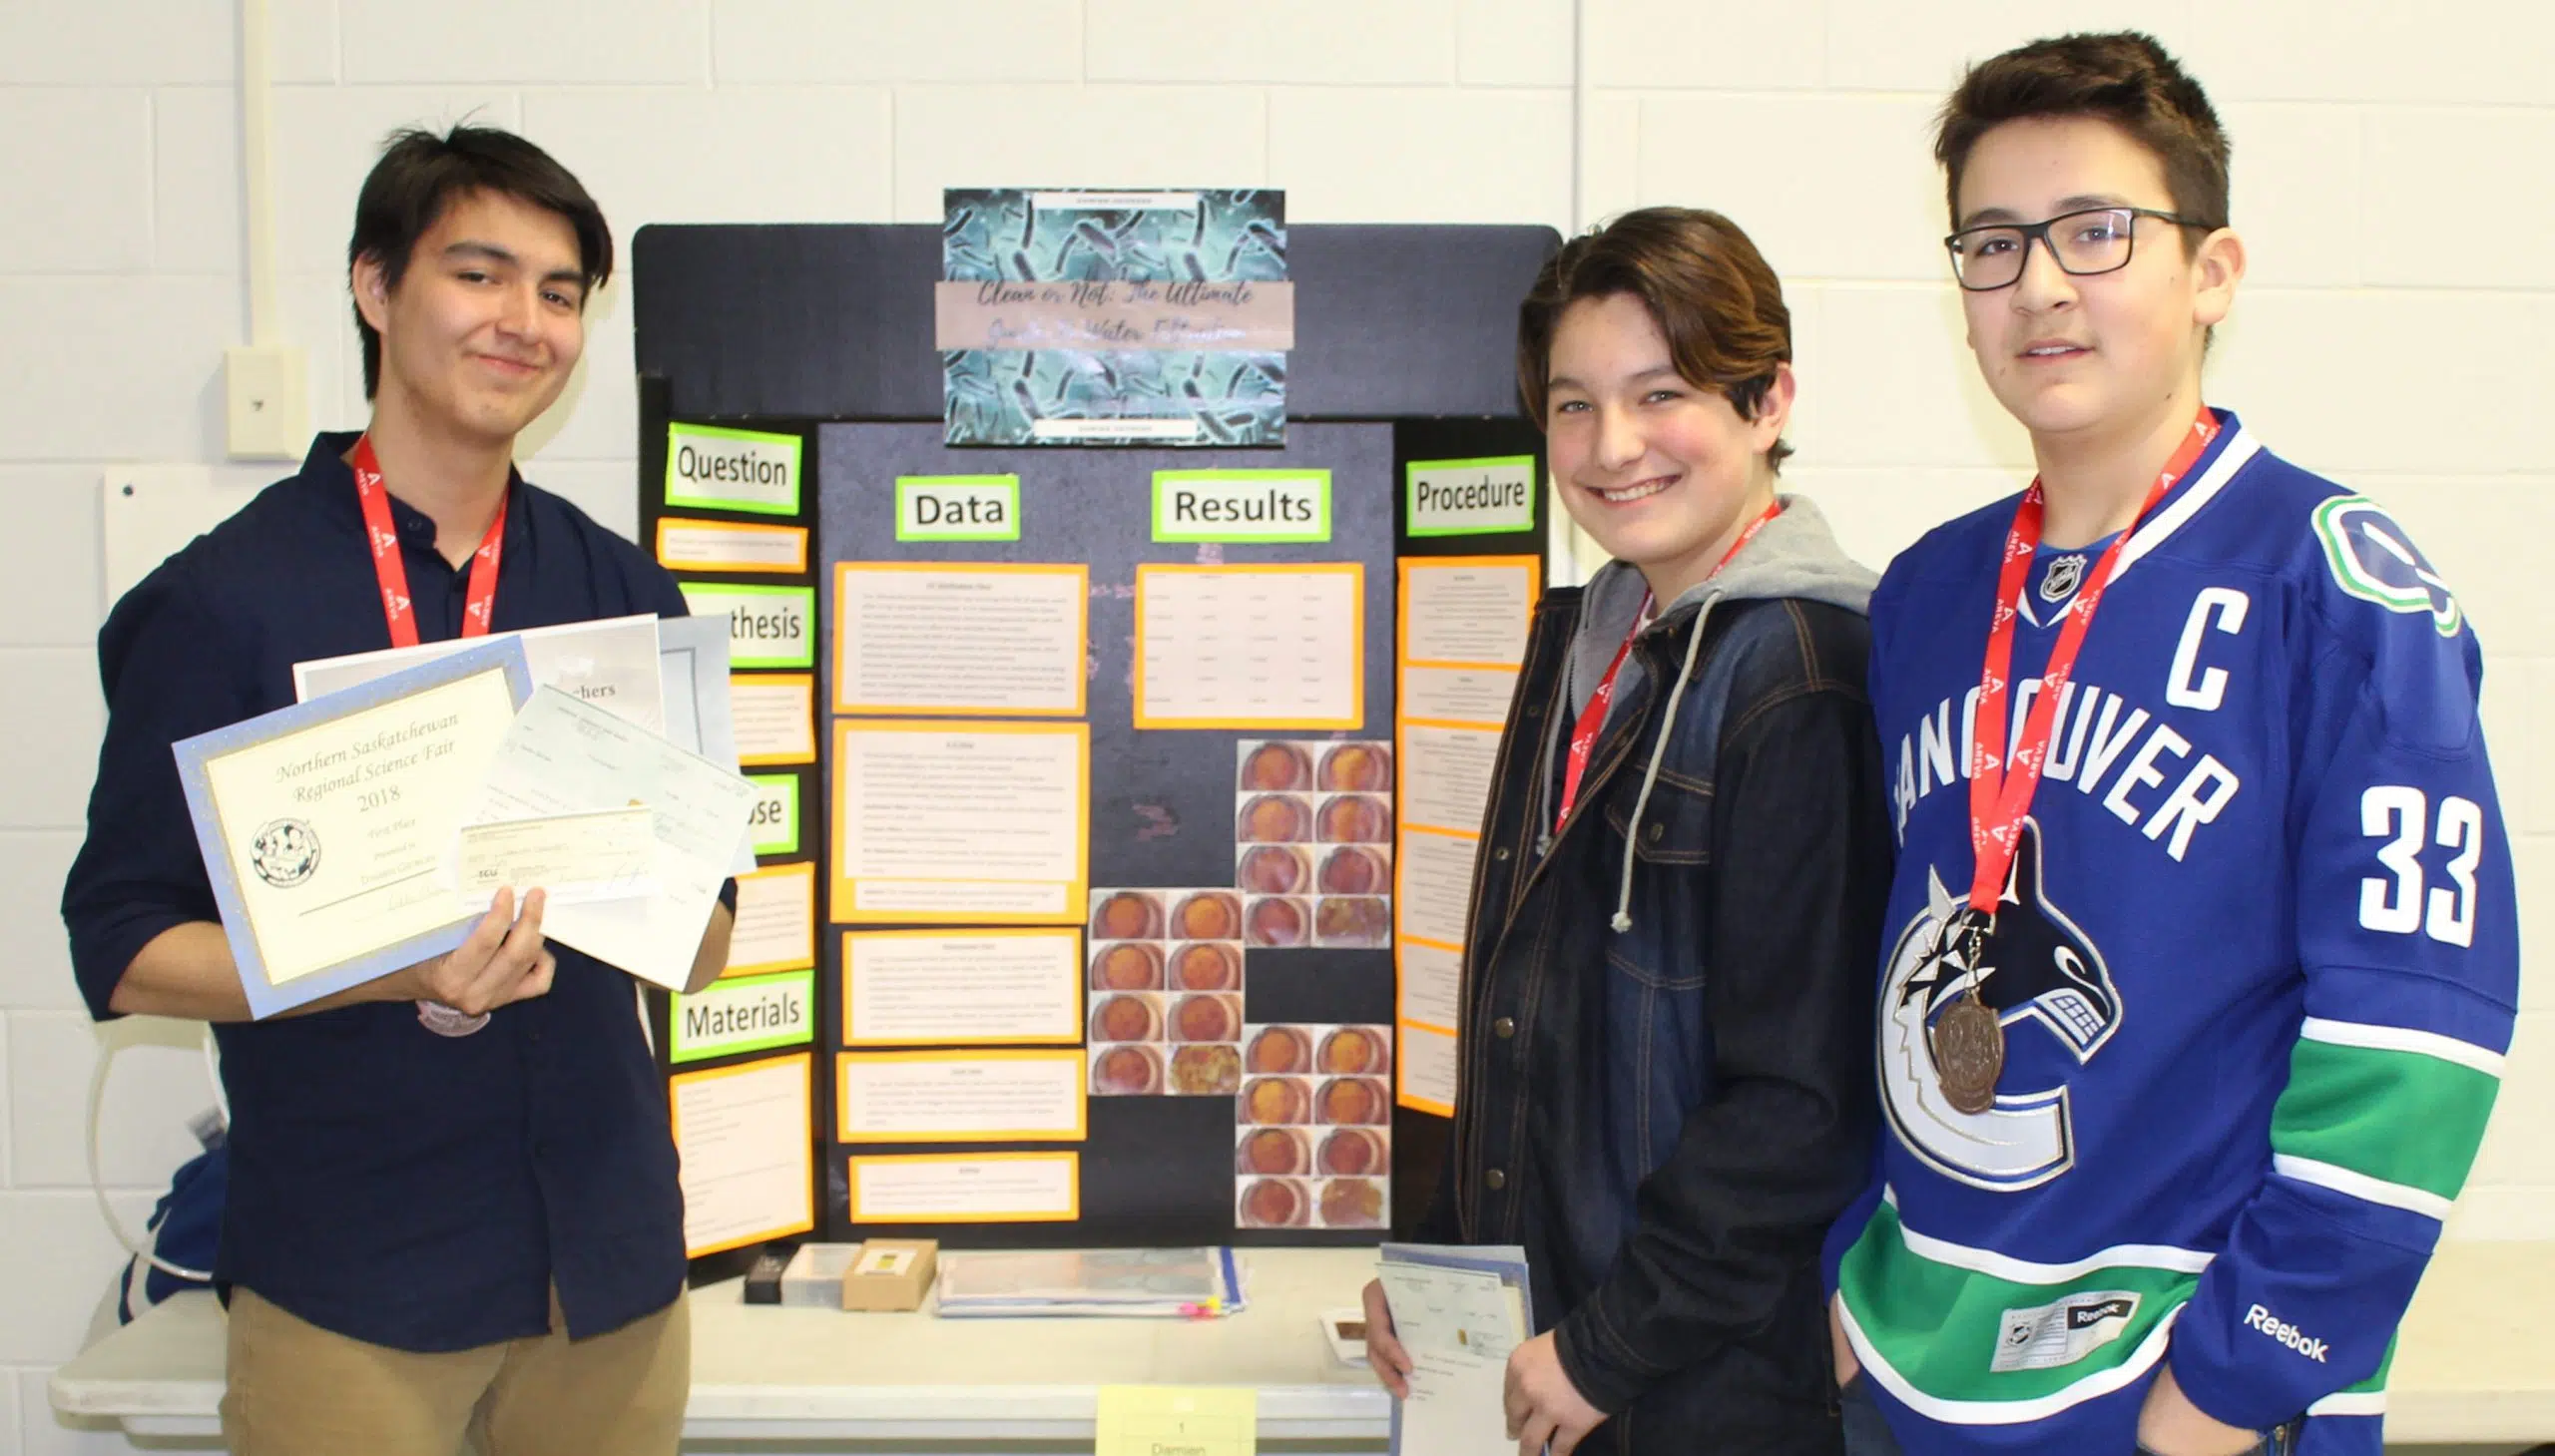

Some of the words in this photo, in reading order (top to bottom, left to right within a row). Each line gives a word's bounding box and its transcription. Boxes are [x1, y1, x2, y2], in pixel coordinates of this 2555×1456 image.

[678, 445, 786, 486] Question
[916, 494, 1004, 525] Data
[1175, 489, 1312, 522] Results
[1417, 474, 1525, 511] Procedure
[2004, 530, 2020, 564] AREVA
[731, 606, 800, 640] thesis
[1991, 598, 2005, 634] AREVA
[2165, 587, 2251, 712] C
[1979, 667, 1992, 706] AREVA
[2052, 663, 2071, 701] AREVA
[275, 749, 347, 783] Northern
[351, 714, 459, 759] Saskatchewan
[2028, 739, 2046, 779] AREVA
[292, 764, 360, 803] Regional
[364, 752, 418, 782] Science
[421, 738, 456, 761] Fair
[356, 784, 403, 813] 2018
[2003, 817, 2021, 856] AREVA
[2358, 785, 2482, 948] 33
[687, 992, 799, 1039] Materials
[2244, 1303, 2329, 1363] Reebok
